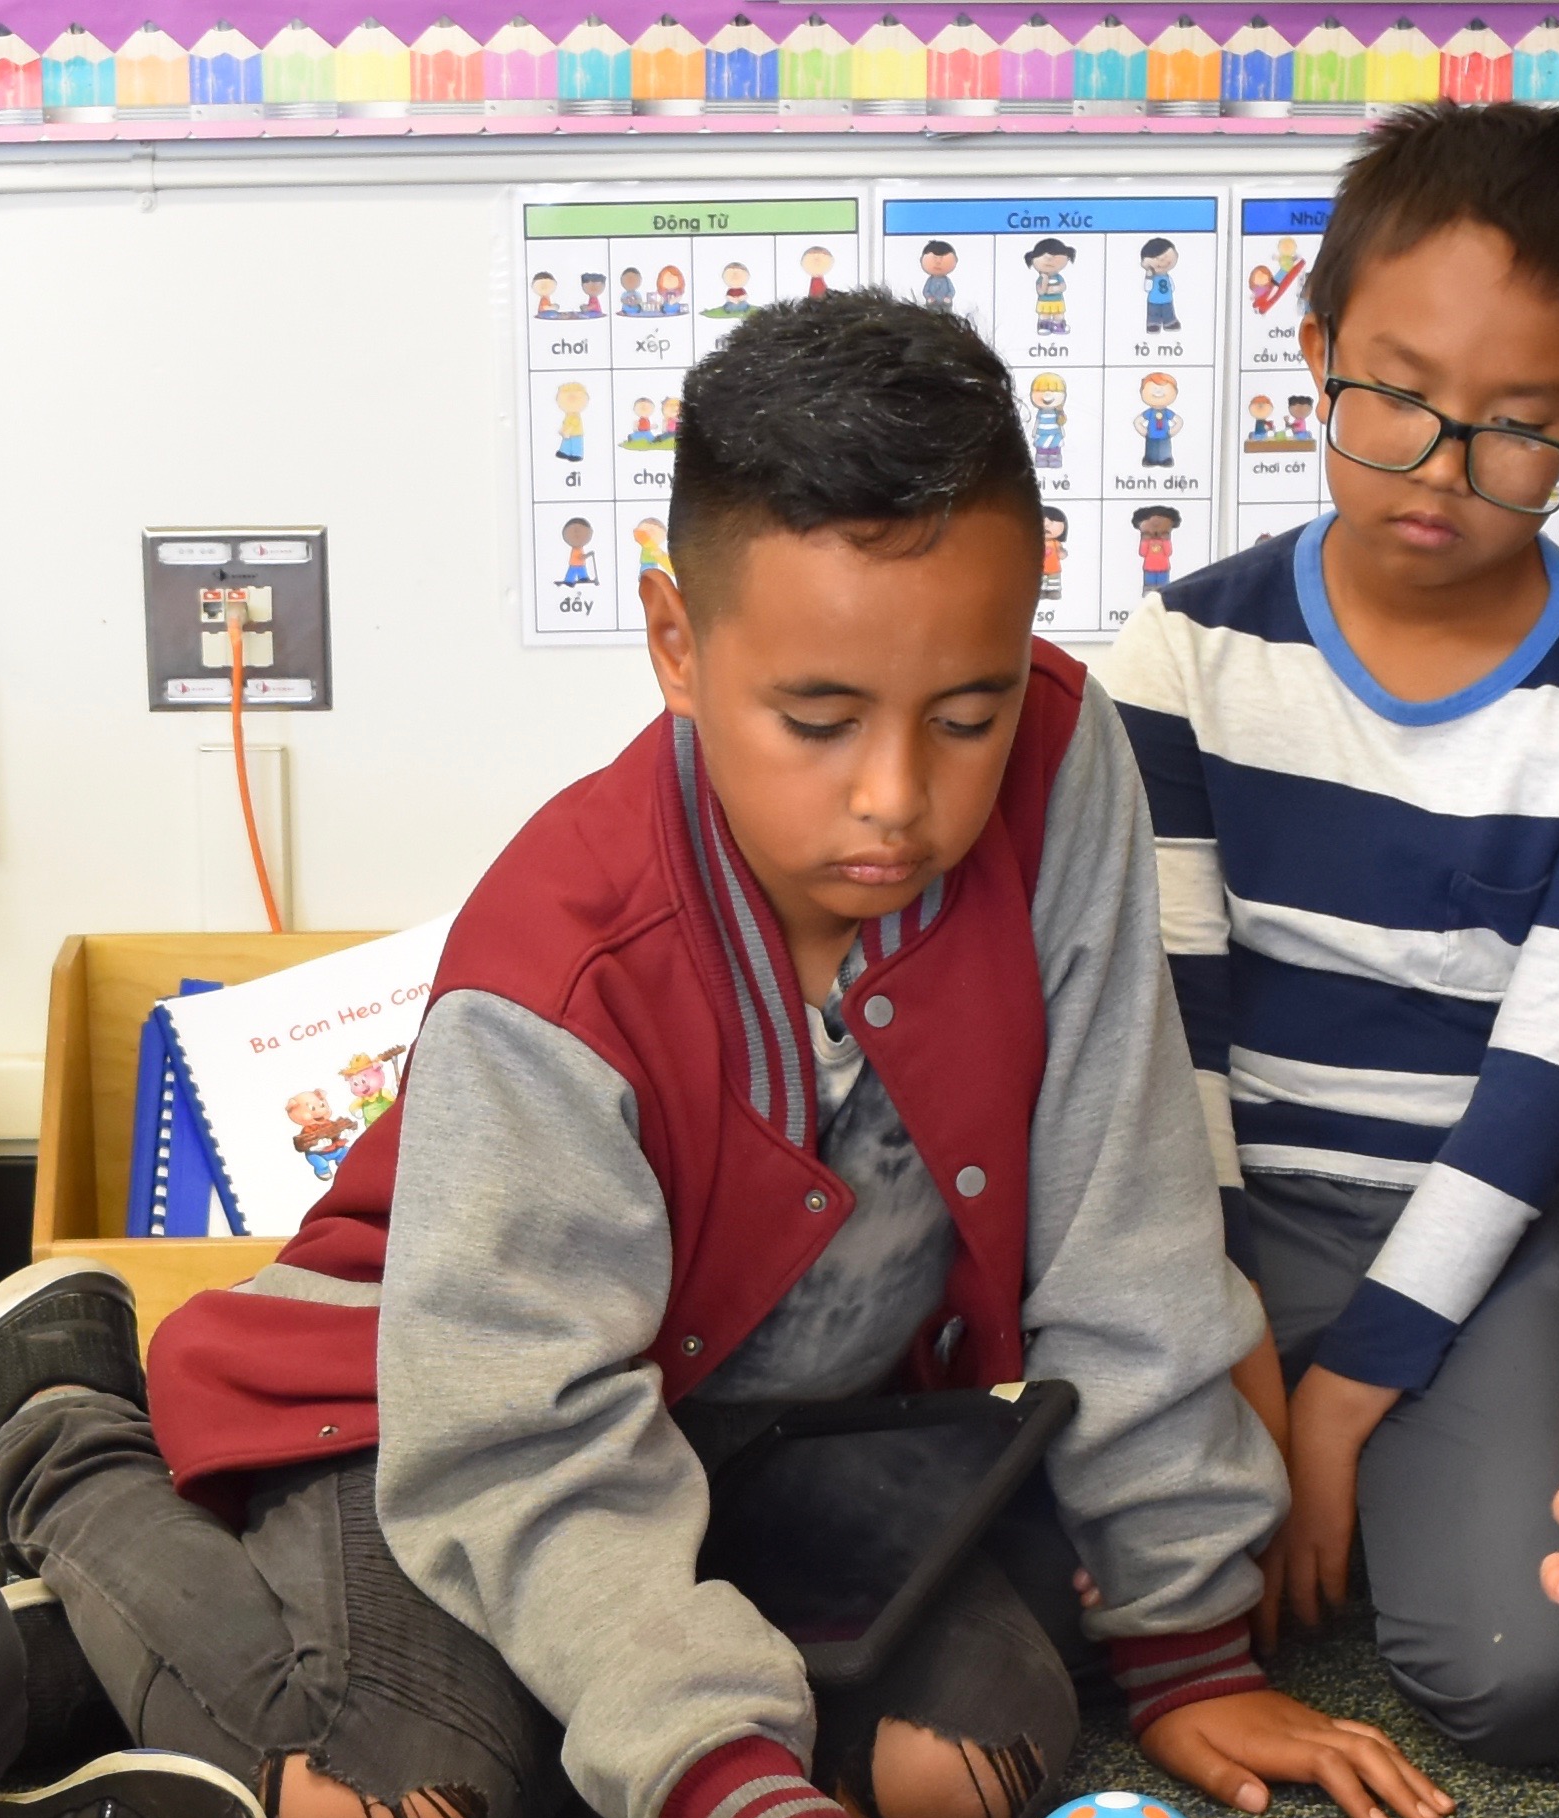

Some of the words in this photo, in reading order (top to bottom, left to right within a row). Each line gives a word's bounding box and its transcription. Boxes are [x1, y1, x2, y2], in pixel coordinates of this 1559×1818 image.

[1007, 209, 1051, 229] Cảm
[1058, 210, 1094, 229] Xúc
[551, 337, 589, 355] chơi
[635, 327, 671, 360] xếp
[1028, 342, 1070, 358] chán
[249, 1036, 281, 1054] Ba
[289, 1019, 331, 1042] Con
[337, 1001, 382, 1025] Heo
[390, 982, 432, 1006] Con
